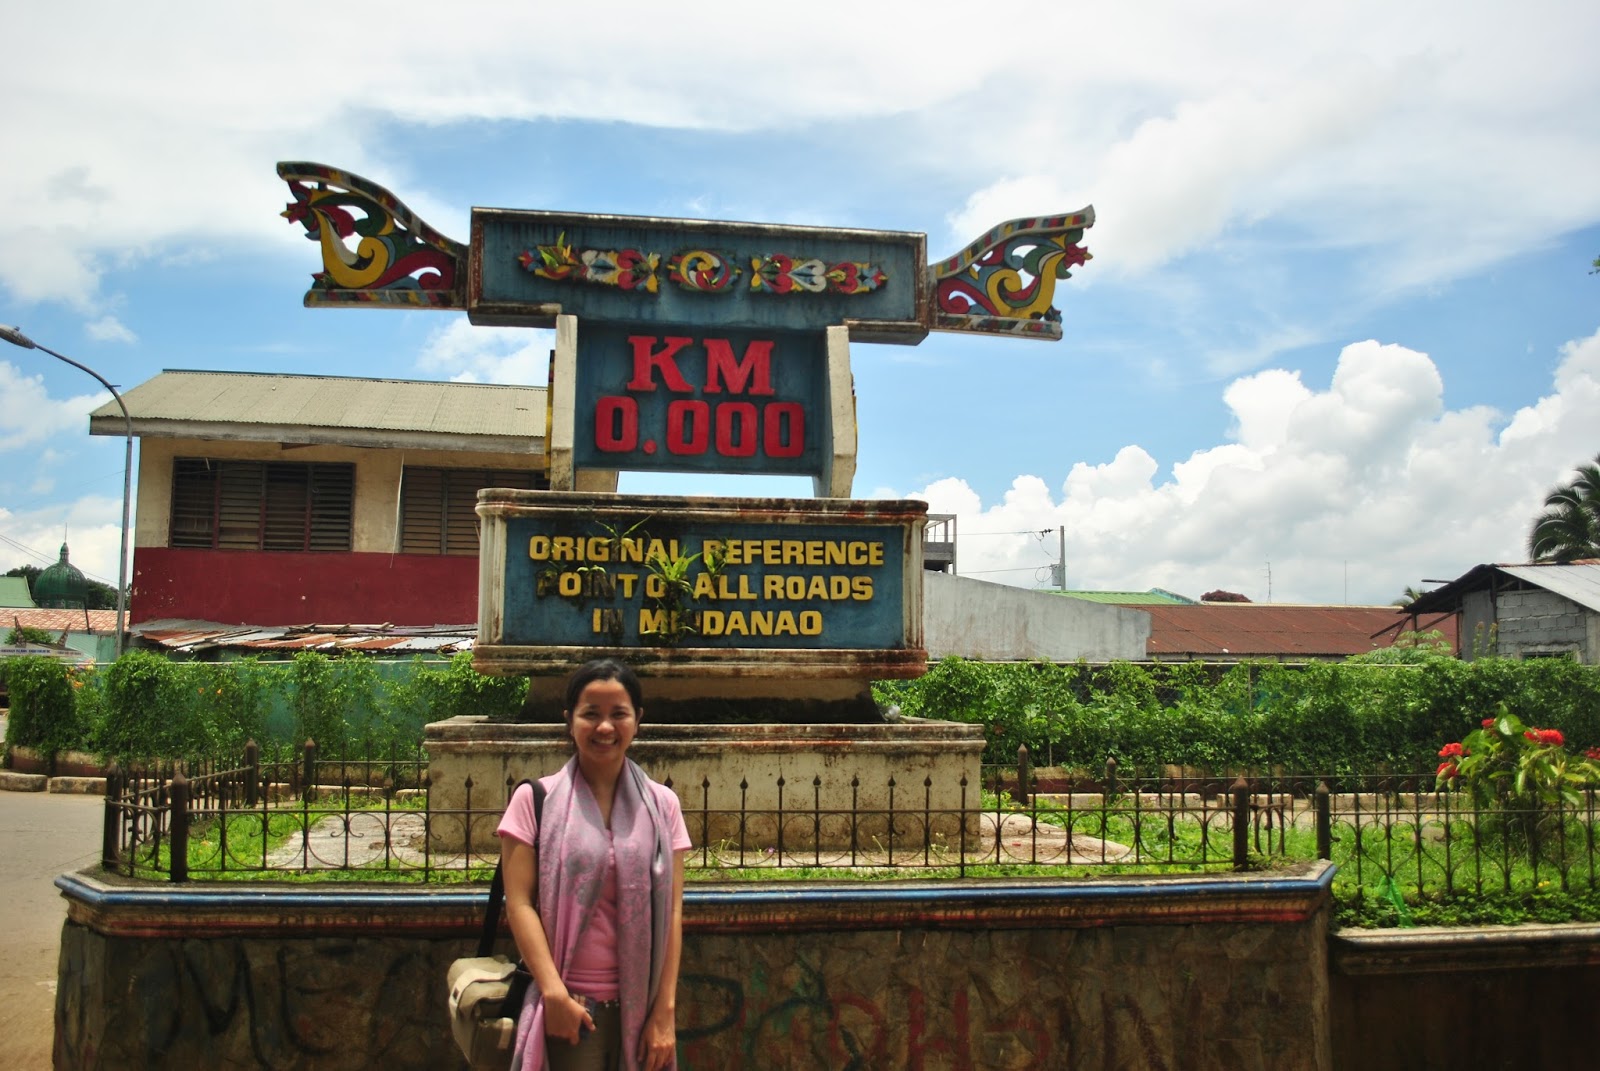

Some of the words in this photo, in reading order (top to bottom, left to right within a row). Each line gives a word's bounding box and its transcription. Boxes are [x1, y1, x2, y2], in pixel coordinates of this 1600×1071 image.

[627, 335, 775, 395] KM
[595, 395, 805, 457] 0.000
[529, 535, 684, 563] ORIGINAL
[703, 540, 884, 565] REFERENCE
[537, 571, 639, 599] POINT
[646, 573, 688, 600] O
[693, 573, 758, 599] ALL
[764, 574, 874, 600] ROADS
[592, 608, 624, 634] IN
